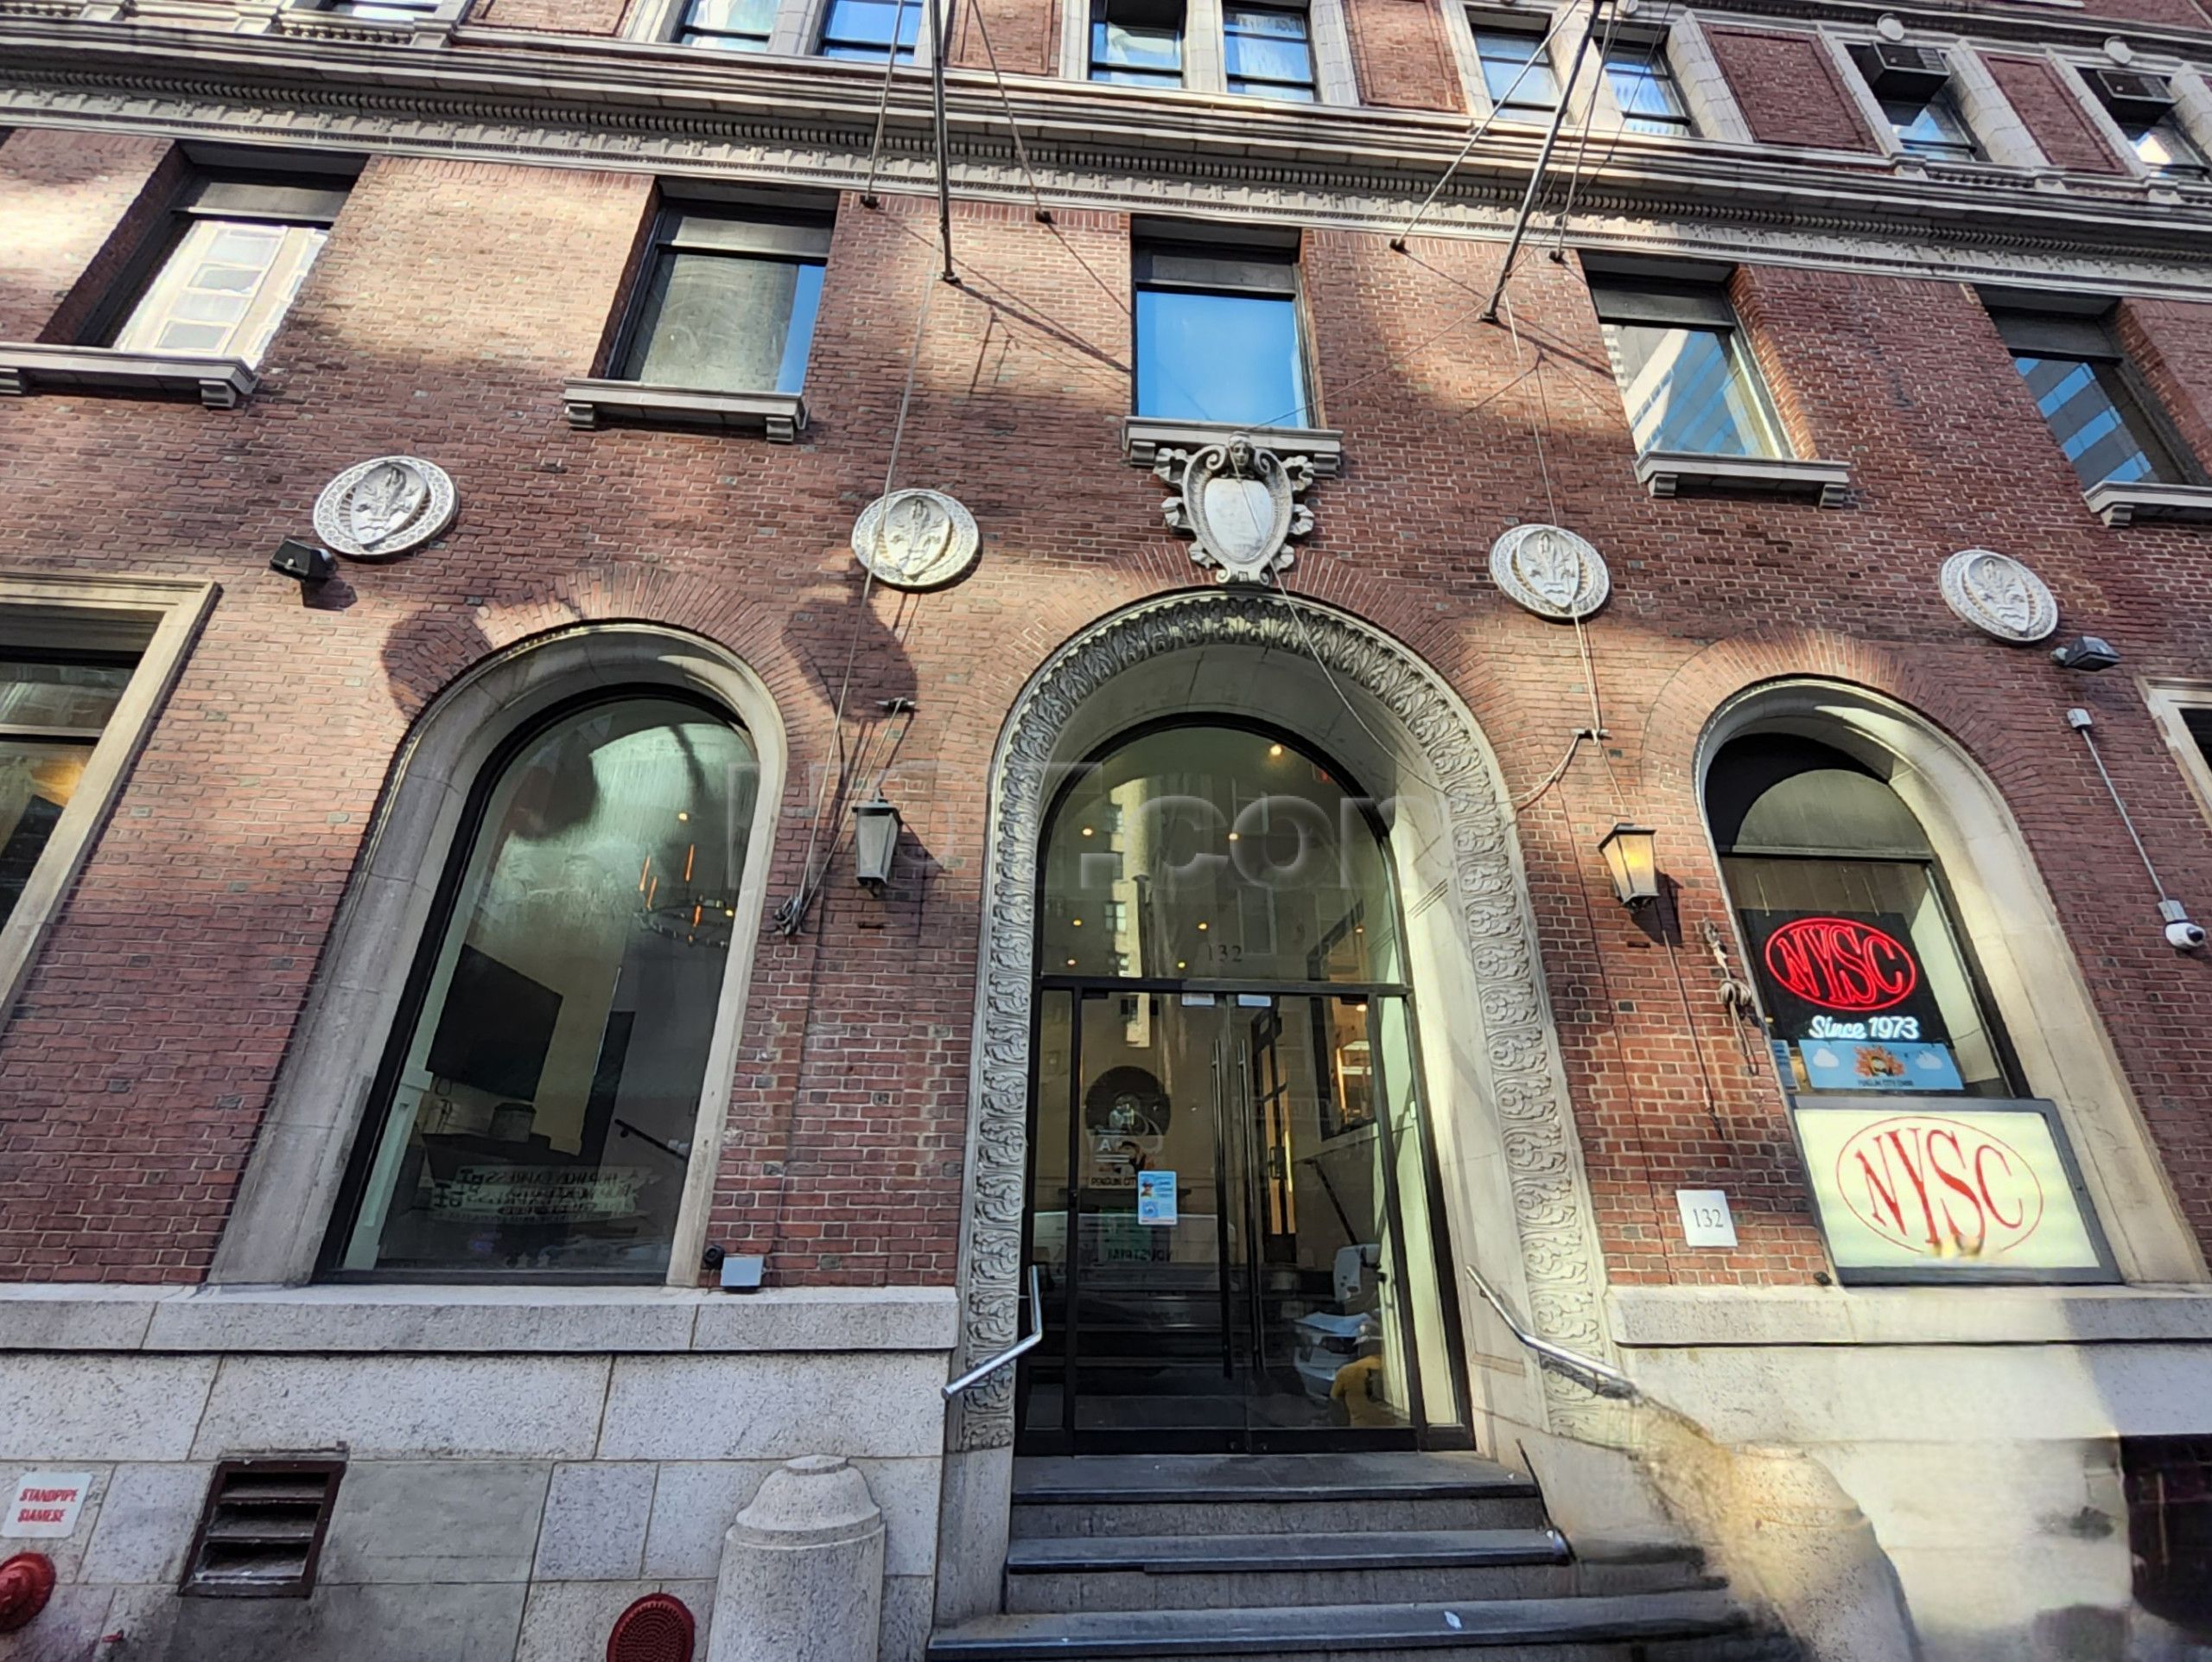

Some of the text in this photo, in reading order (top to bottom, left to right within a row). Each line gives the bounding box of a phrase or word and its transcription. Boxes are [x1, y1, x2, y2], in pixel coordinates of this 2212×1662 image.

[1208, 944, 1243, 962] 132
[1776, 924, 1904, 1006] NYSC
[1808, 1014, 1920, 1040] Since 1973
[1854, 1127, 2024, 1258] NYSC
[1693, 1207, 1725, 1228] 132
[19, 1488, 79, 1502] STANDPIPE
[17, 1508, 66, 1523] SIAMESE
